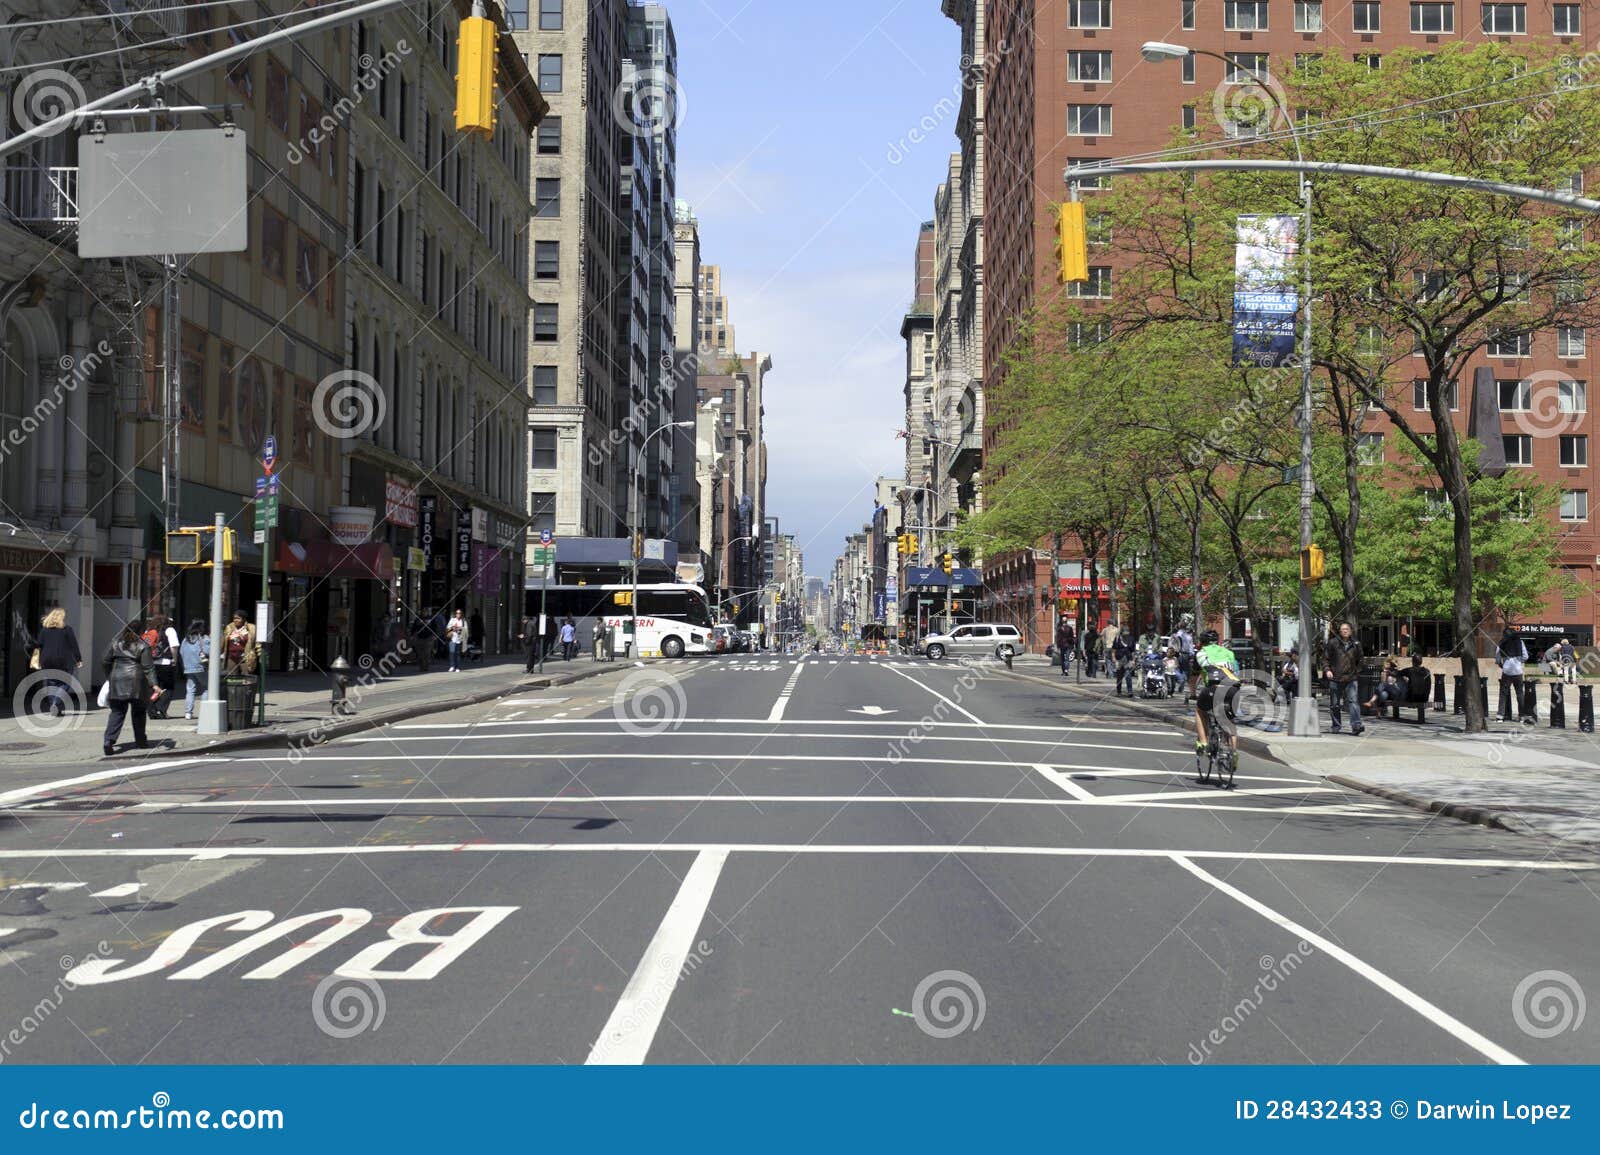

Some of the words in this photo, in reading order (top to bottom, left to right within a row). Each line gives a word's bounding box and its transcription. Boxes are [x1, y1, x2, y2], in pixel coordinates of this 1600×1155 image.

[1284, 295, 1296, 303] TO
[608, 618, 655, 628] EAERN
[1540, 625, 1564, 633] Parking
[65, 906, 520, 986] BUS
